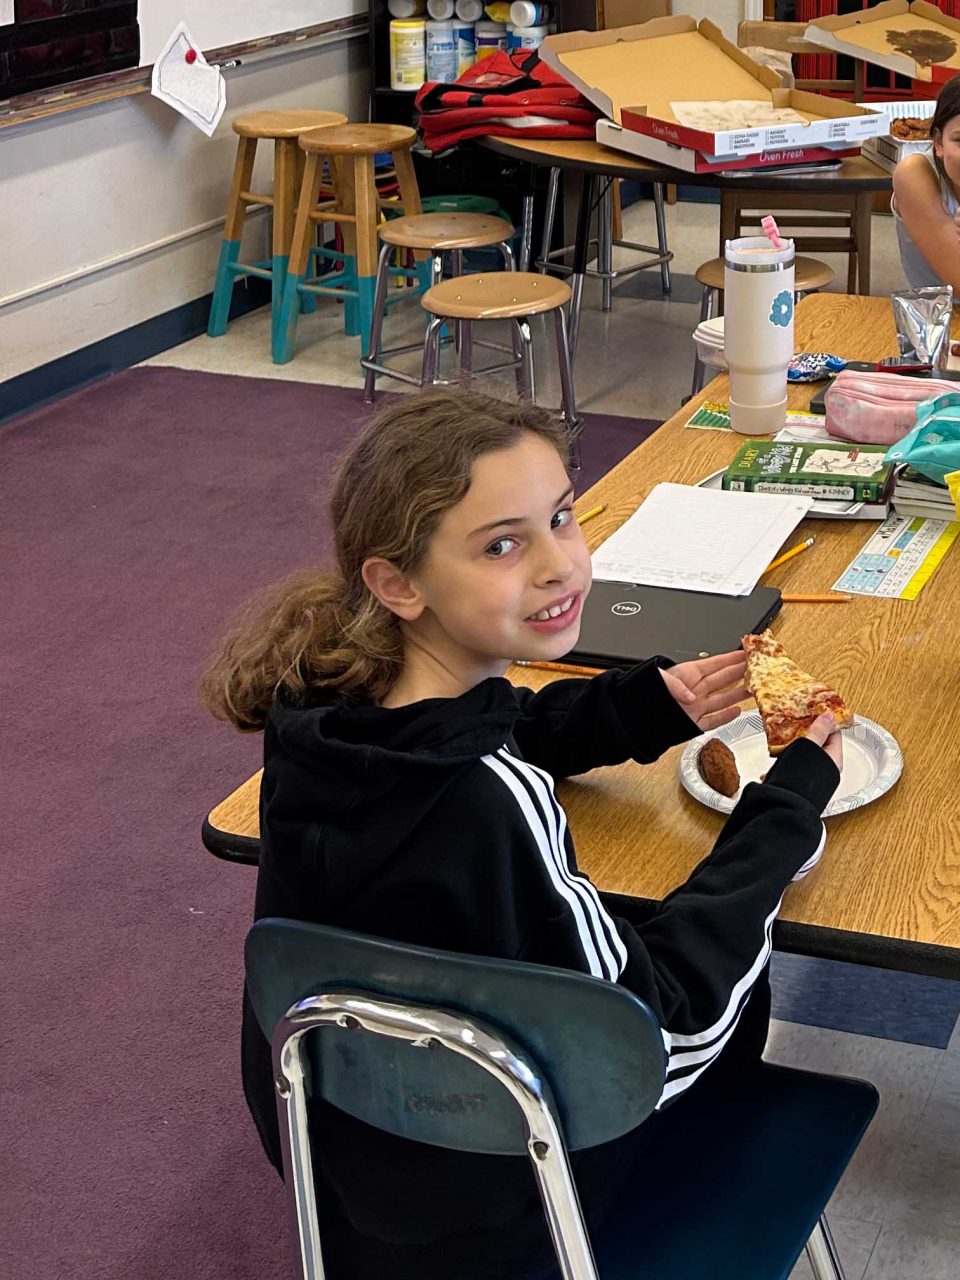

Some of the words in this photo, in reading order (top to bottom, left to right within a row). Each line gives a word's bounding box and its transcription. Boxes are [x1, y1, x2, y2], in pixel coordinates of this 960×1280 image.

[759, 152, 781, 162] Oven
[782, 149, 804, 160] Fresh
[738, 448, 760, 468] DIARY
